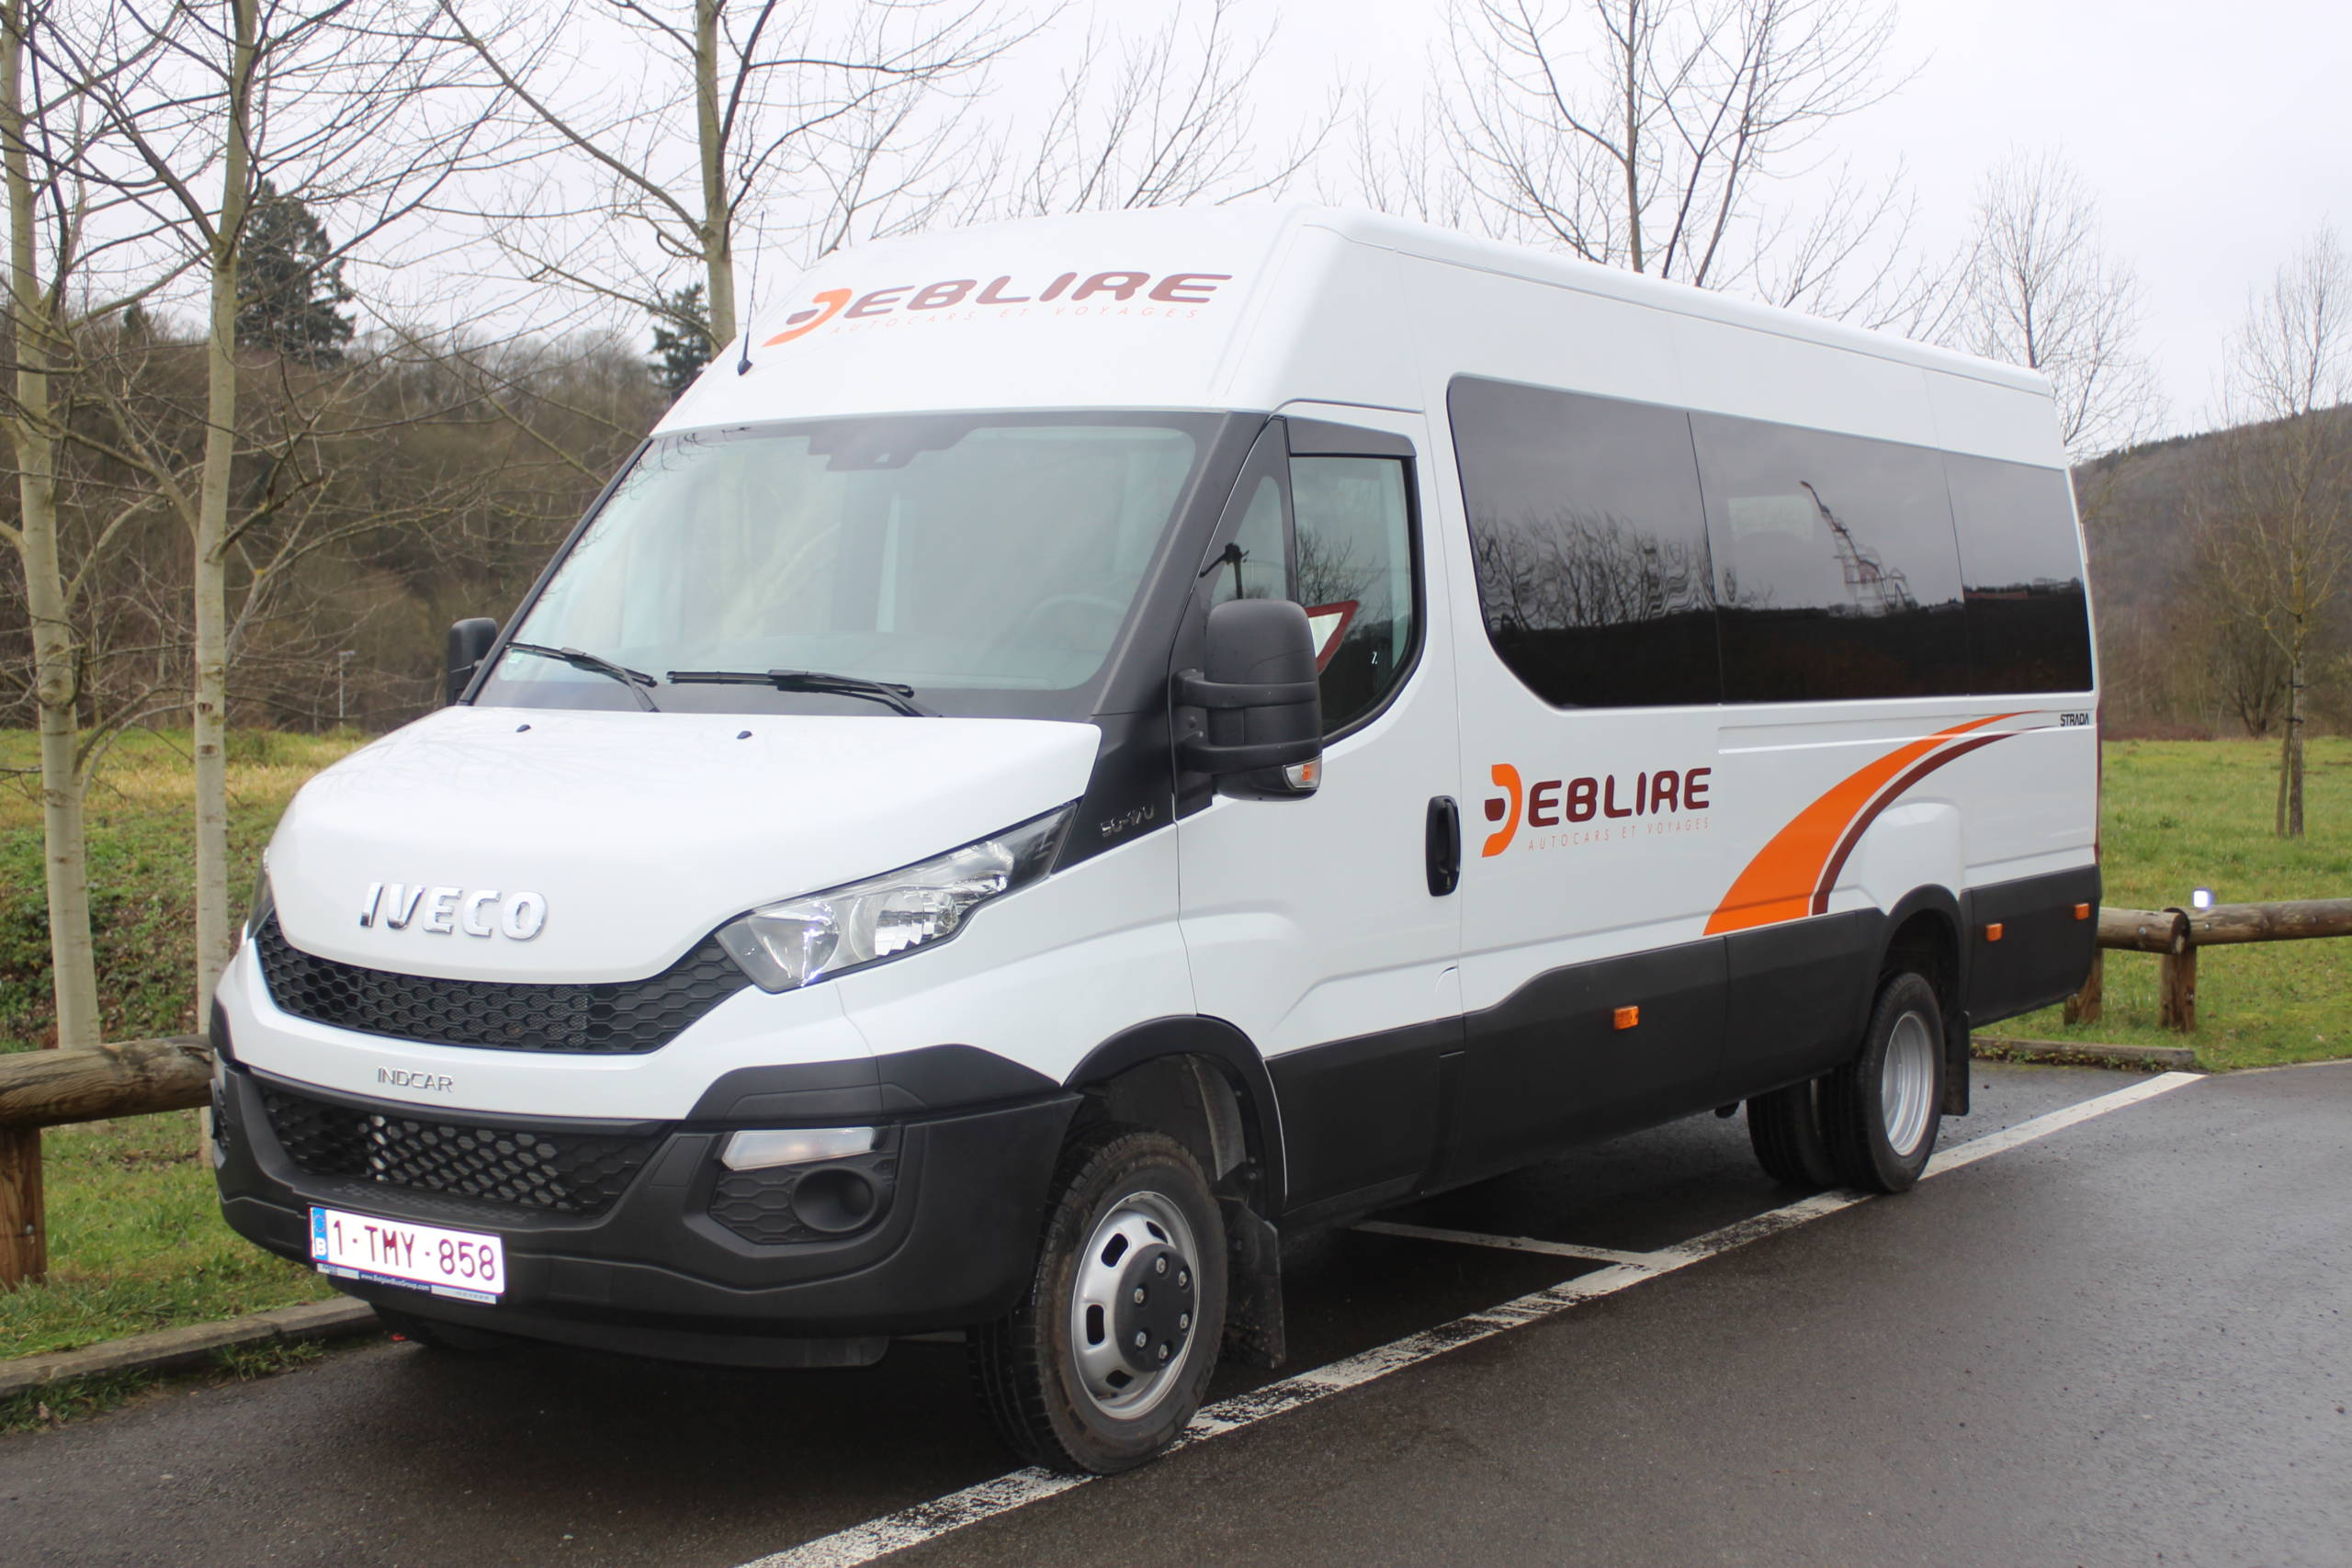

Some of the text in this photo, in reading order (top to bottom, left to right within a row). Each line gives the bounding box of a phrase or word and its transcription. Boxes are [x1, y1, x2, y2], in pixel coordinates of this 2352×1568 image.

[2060, 713, 2089, 727] STRADA
[1528, 817, 1710, 852] AUTOCARS ET VOYAGES
[360, 882, 548, 942] IVECO
[378, 1066, 454, 1093] INDCAR
[333, 1219, 496, 1281] 1-TMY-858
